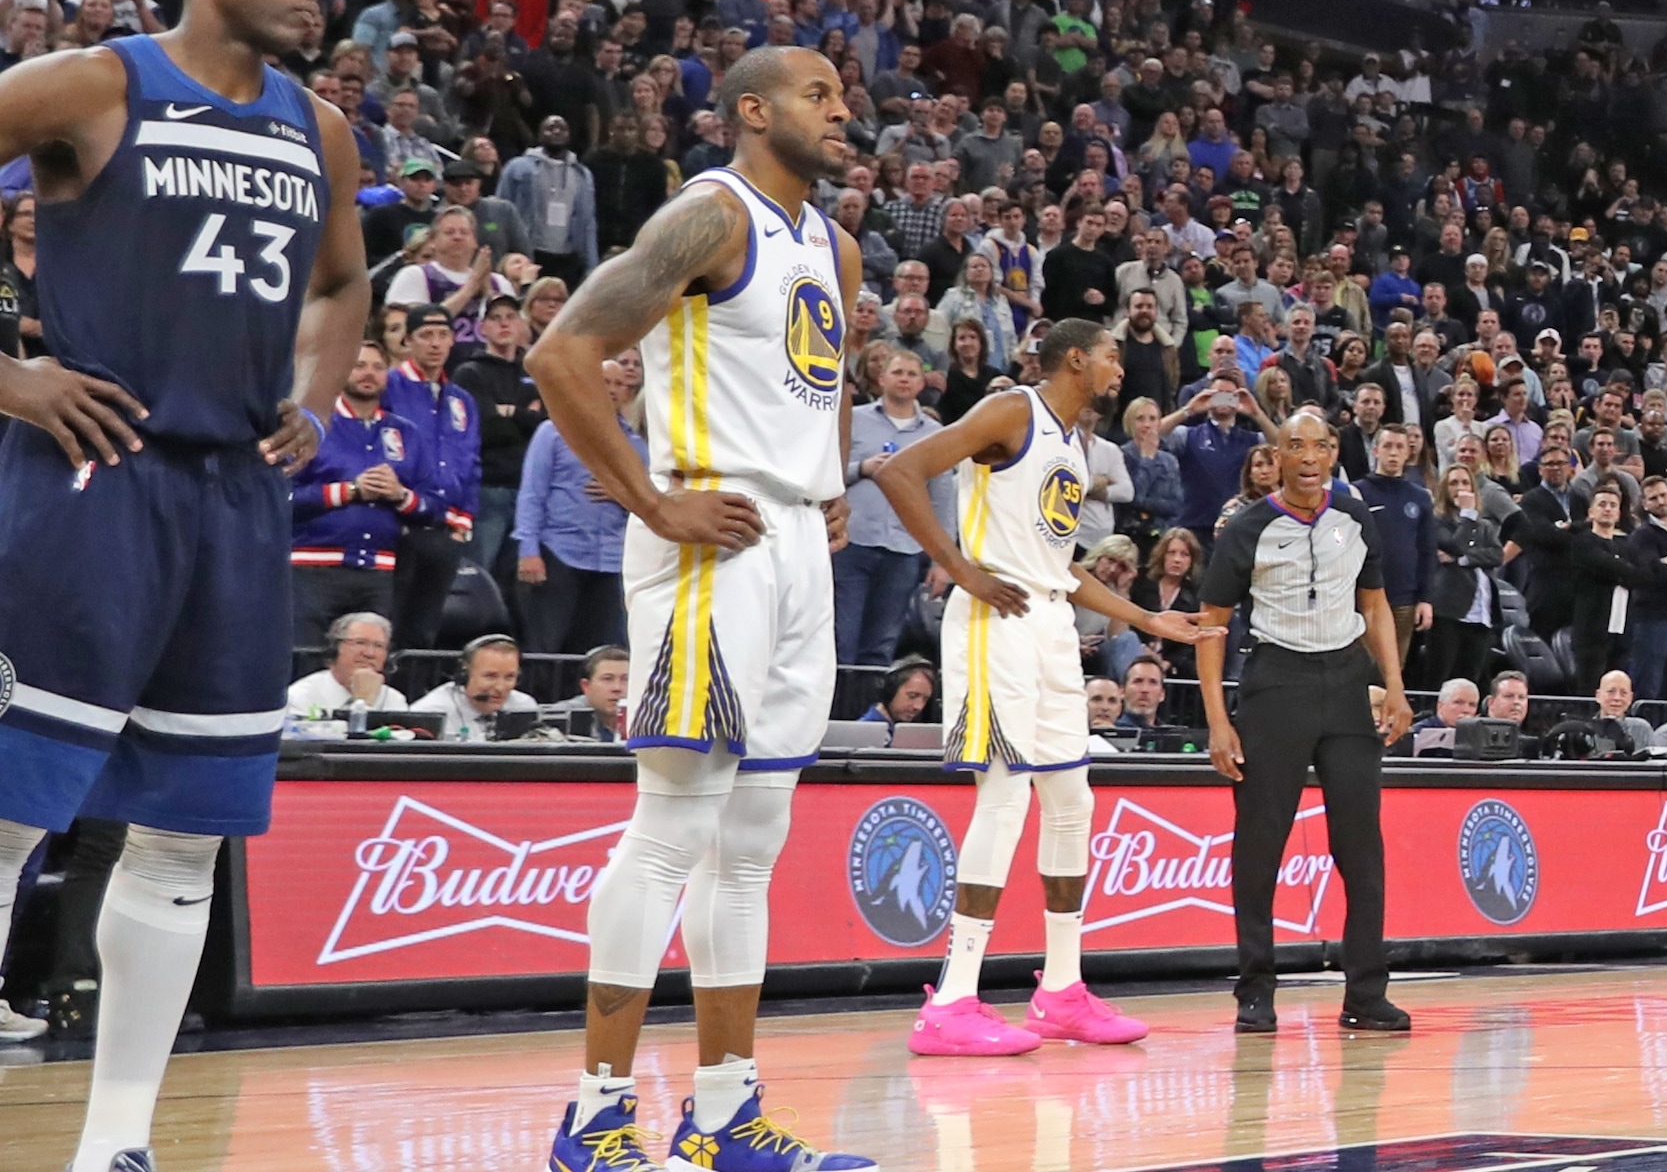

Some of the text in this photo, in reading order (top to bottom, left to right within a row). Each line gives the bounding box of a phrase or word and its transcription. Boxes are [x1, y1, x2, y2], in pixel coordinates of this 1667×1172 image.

[144, 155, 321, 222] MINNESOTA
[180, 213, 297, 303] 43
[818, 300, 834, 330] 9
[1062, 479, 1081, 504] 35
[851, 802, 956, 921] MINNESOTA TIMBERWOLVES
[1460, 804, 1535, 902] MINNESOTA TIMBERWOLVES
